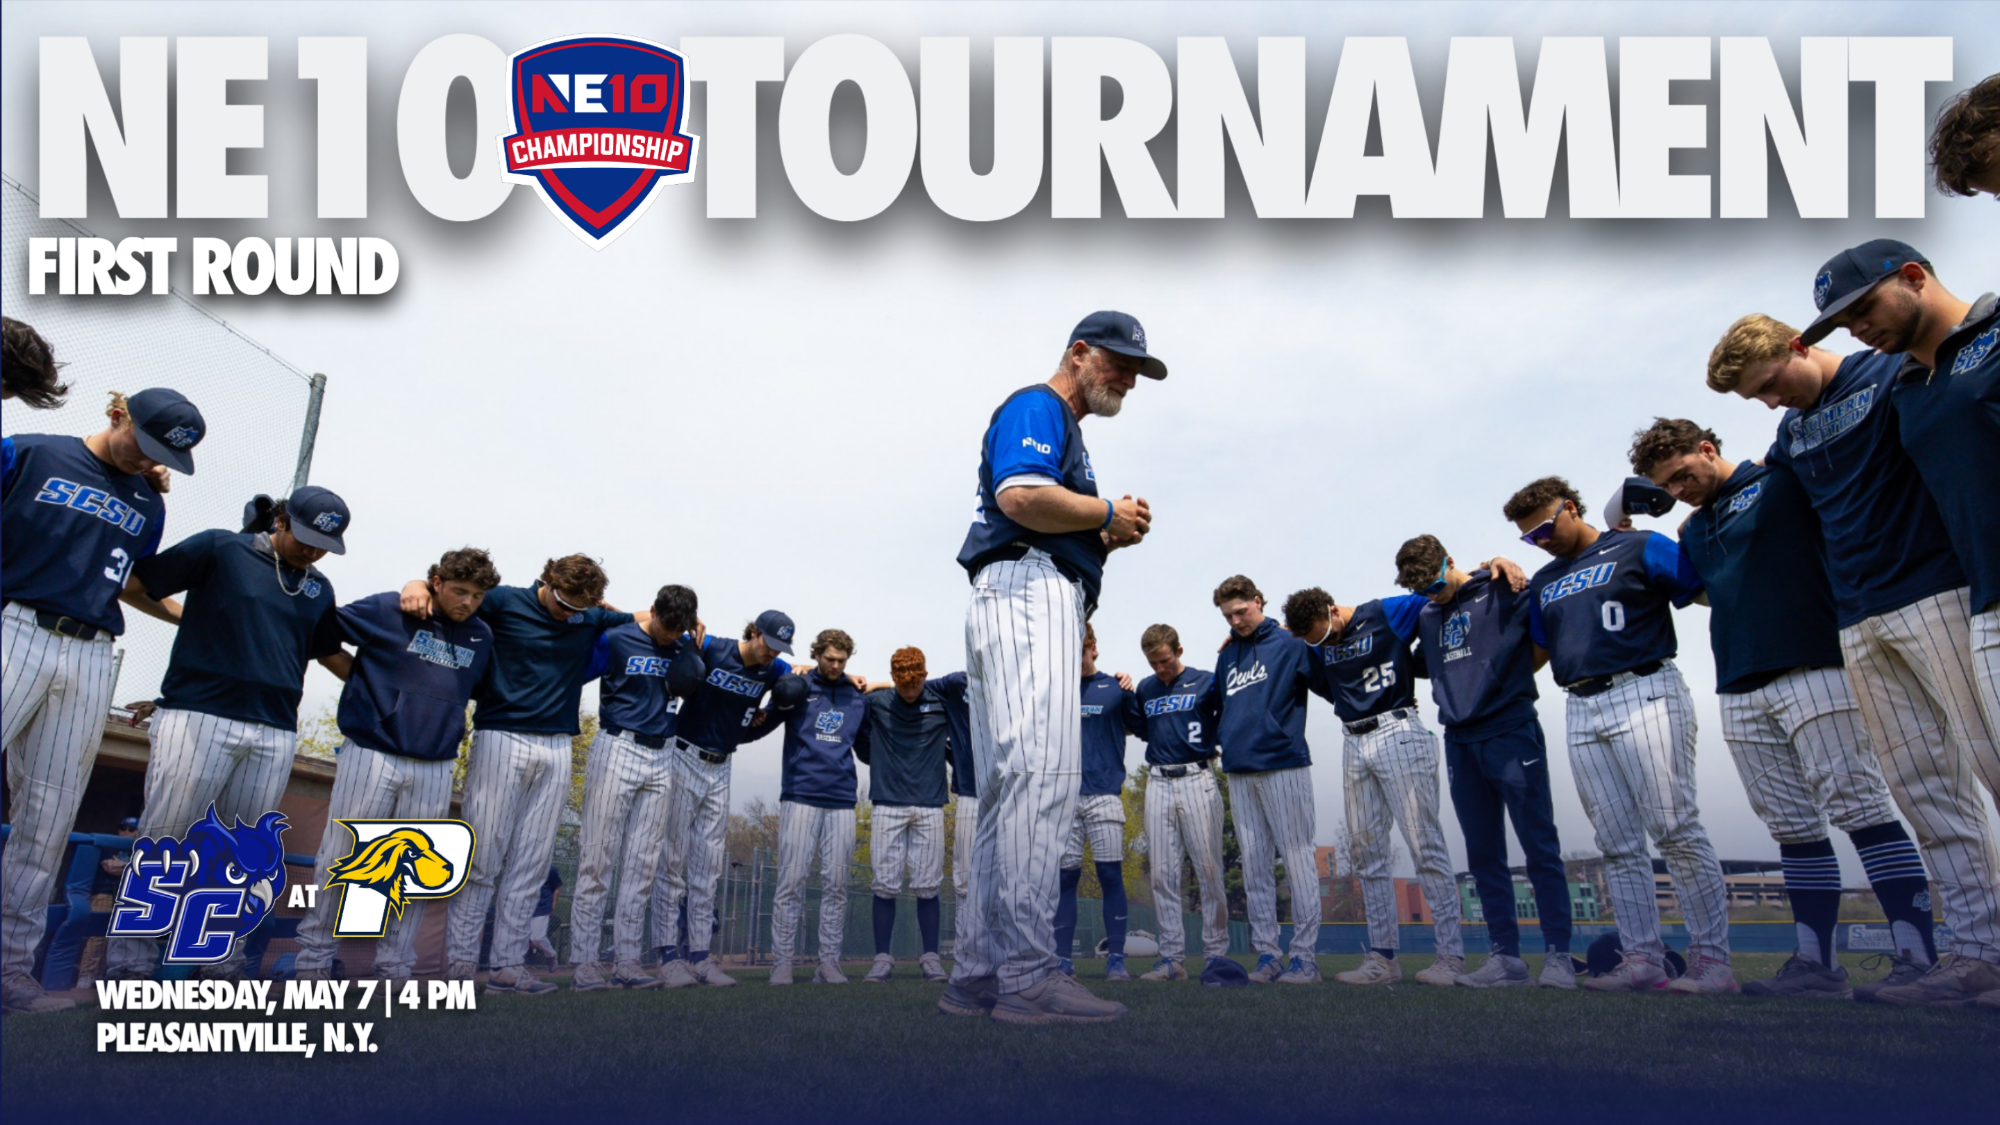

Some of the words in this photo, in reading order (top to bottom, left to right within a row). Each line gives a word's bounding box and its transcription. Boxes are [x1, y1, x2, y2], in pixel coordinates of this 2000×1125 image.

[35, 477, 146, 537] SCSU
[104, 547, 135, 589] 3
[1540, 561, 1617, 608] SCSU
[1602, 600, 1625, 632] 0
[1325, 633, 1373, 665] SCSU
[625, 656, 671, 677] SCS
[1226, 661, 1268, 694] Owls
[1362, 661, 1396, 693] 25
[706, 668, 765, 698] SCSU
[1144, 694, 1197, 717] SCSU
[1188, 722, 1202, 743] 2
